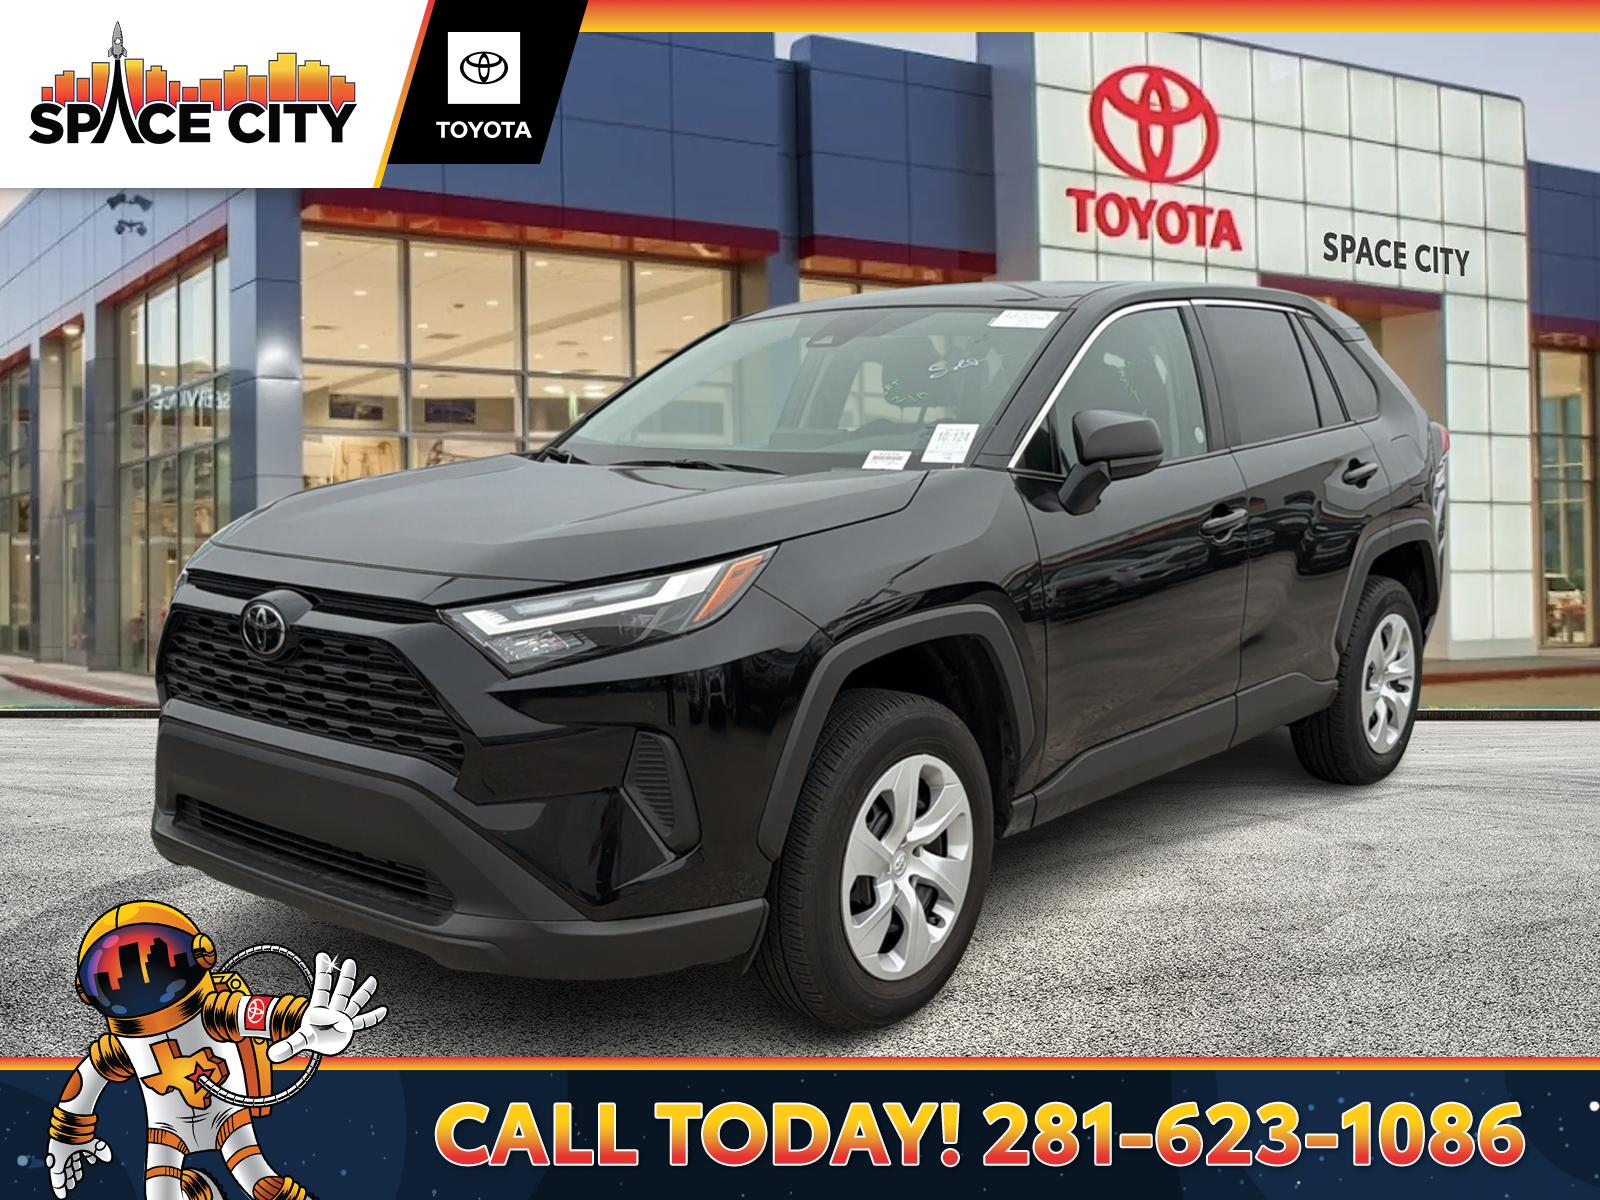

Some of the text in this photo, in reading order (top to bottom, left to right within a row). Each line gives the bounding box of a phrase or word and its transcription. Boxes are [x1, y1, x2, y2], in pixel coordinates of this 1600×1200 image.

[1066, 188, 1242, 251] TOYOTA
[1323, 232, 1470, 277] SPACE CITY
